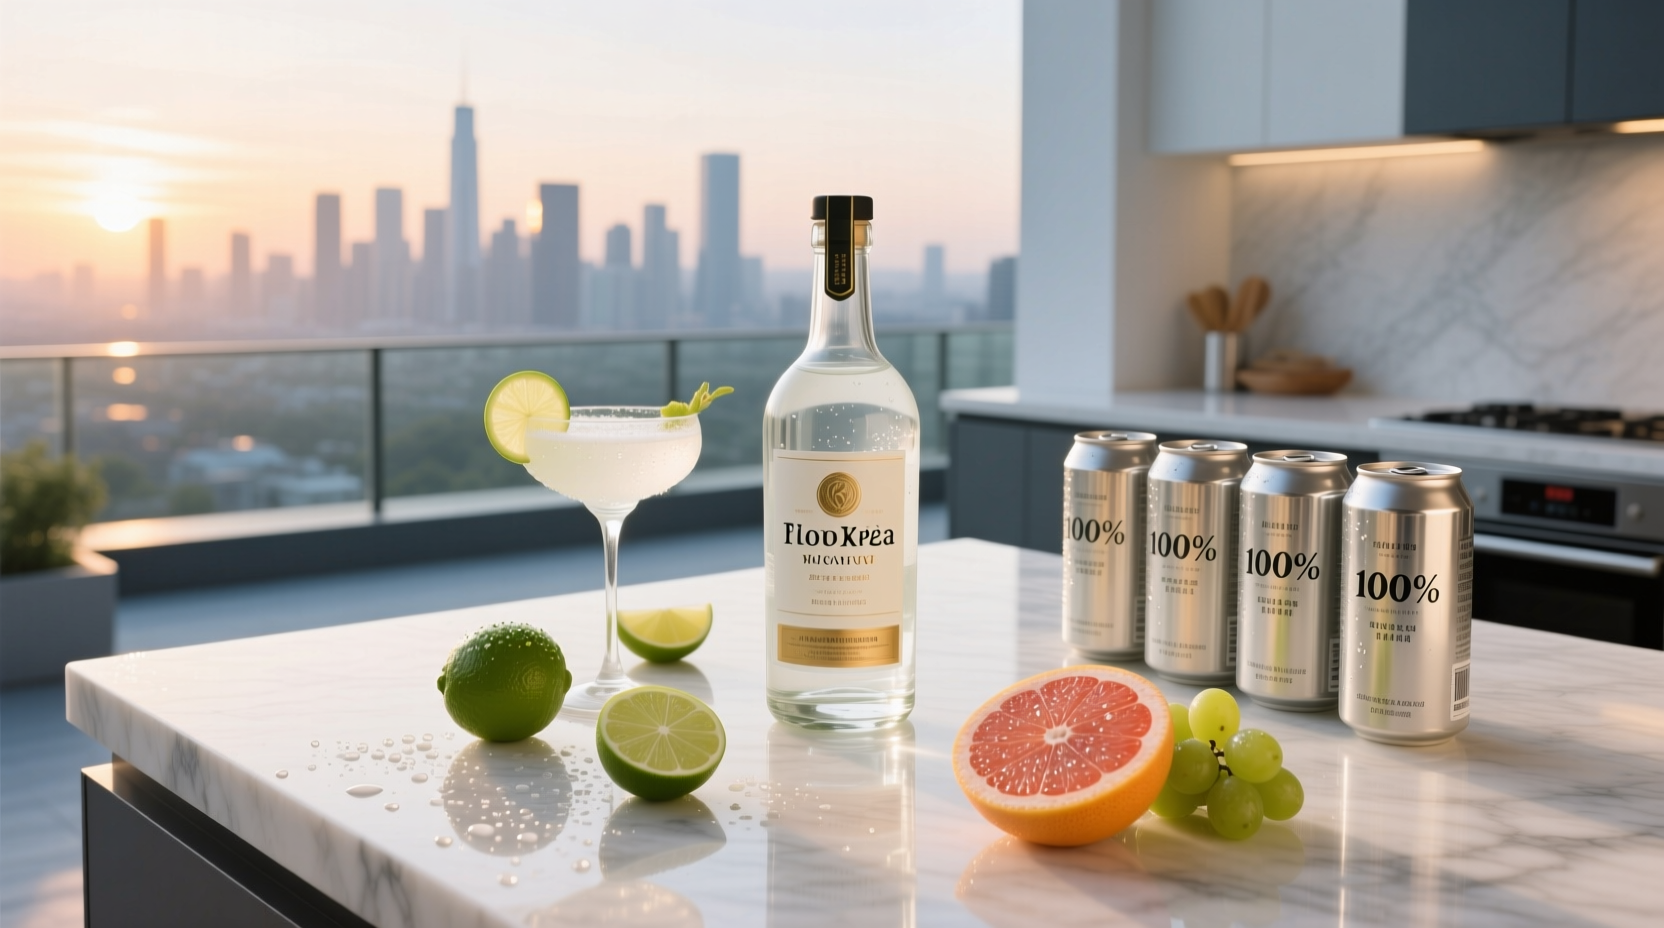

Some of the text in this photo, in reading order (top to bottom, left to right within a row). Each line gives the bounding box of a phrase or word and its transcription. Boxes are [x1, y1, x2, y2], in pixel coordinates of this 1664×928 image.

[1064, 517, 1125, 545] 100%
[1150, 531, 1217, 562] 100%
[1246, 548, 1320, 581] 100%
[1356, 569, 1440, 604] 100%
